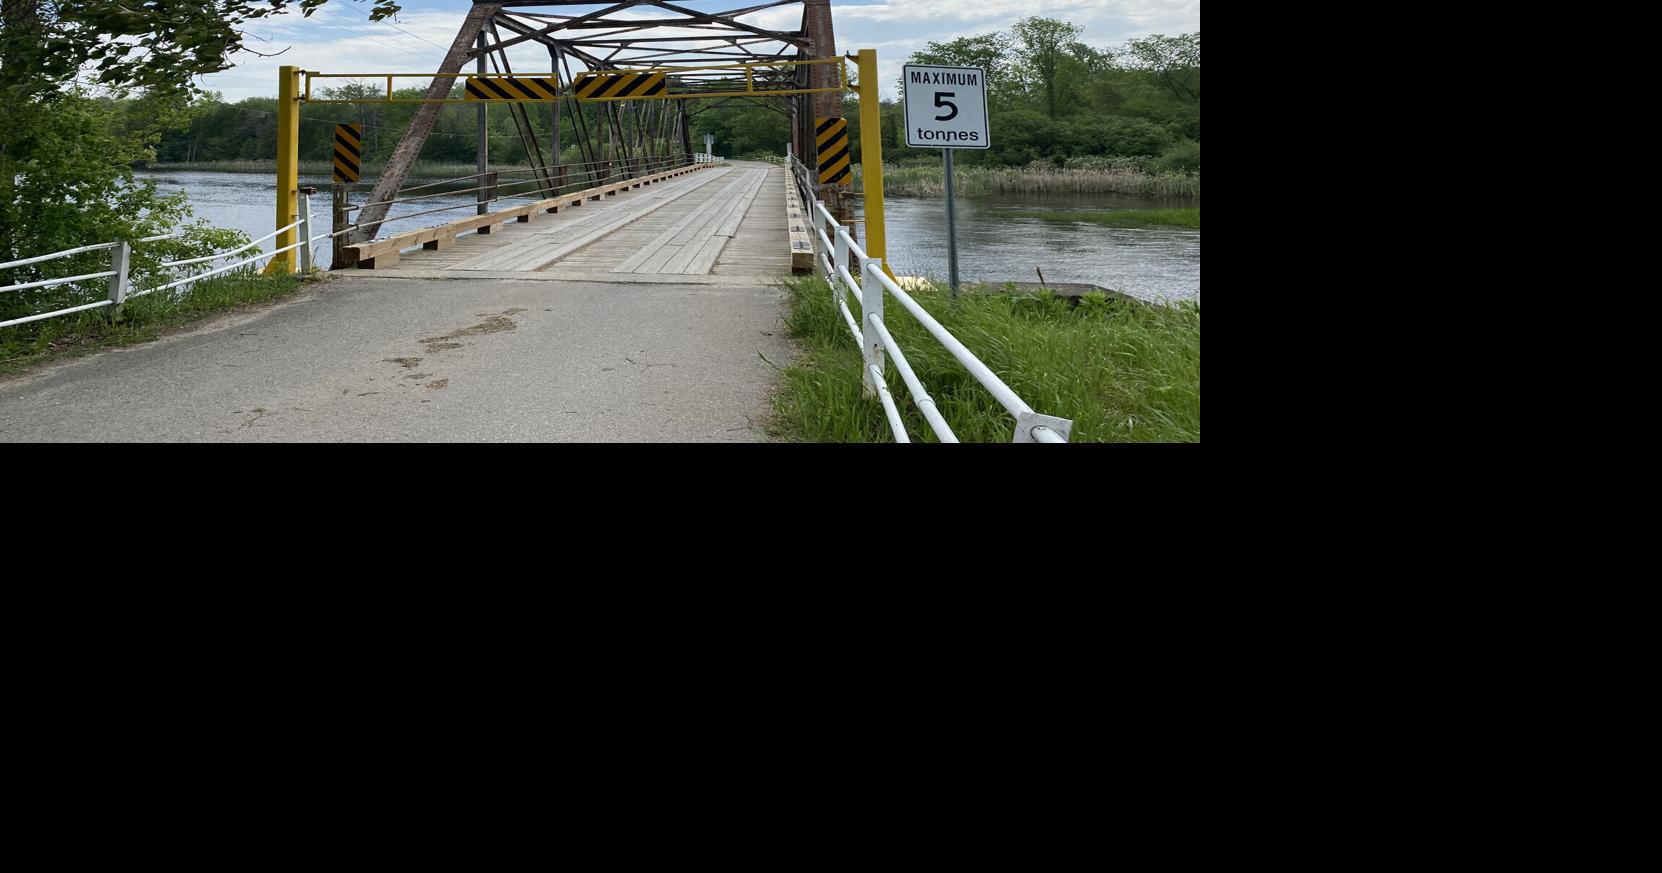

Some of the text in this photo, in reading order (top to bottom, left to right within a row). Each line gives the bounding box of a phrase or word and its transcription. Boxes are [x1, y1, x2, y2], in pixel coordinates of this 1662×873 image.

[910, 71, 978, 86] MAXIMUM
[934, 91, 959, 122] 5
[917, 127, 979, 141] tonnes
